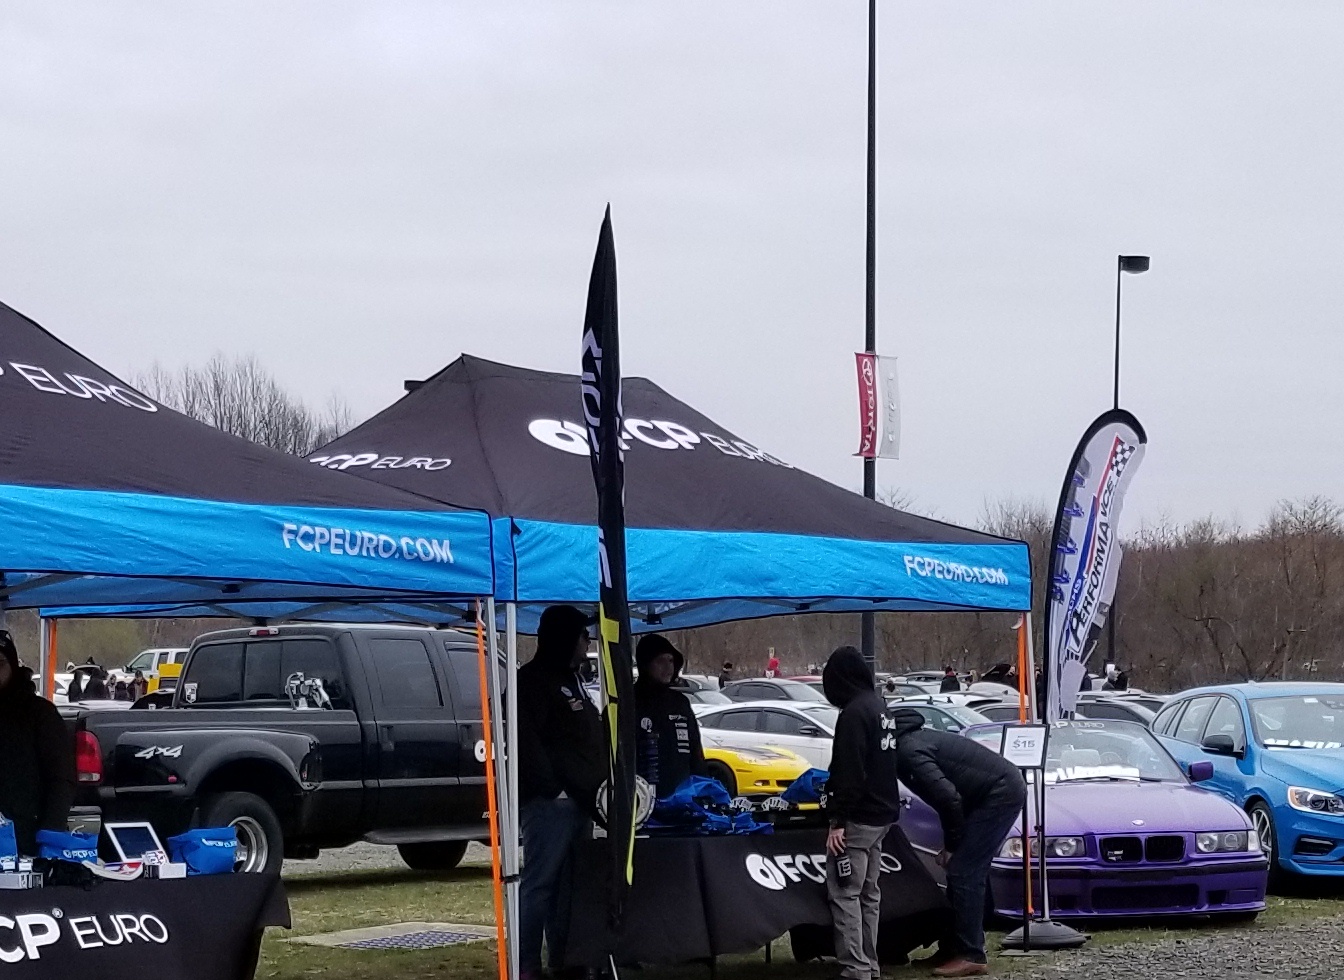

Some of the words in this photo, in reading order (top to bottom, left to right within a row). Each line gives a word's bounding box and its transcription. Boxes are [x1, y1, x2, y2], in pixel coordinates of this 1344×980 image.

[8, 361, 159, 413] EURO
[621, 418, 702, 450] CP
[370, 456, 452, 471] EURO
[282, 522, 455, 565] FCPEURO.COM
[1012, 739, 1036, 749] $15
[68, 913, 169, 949] EURO
